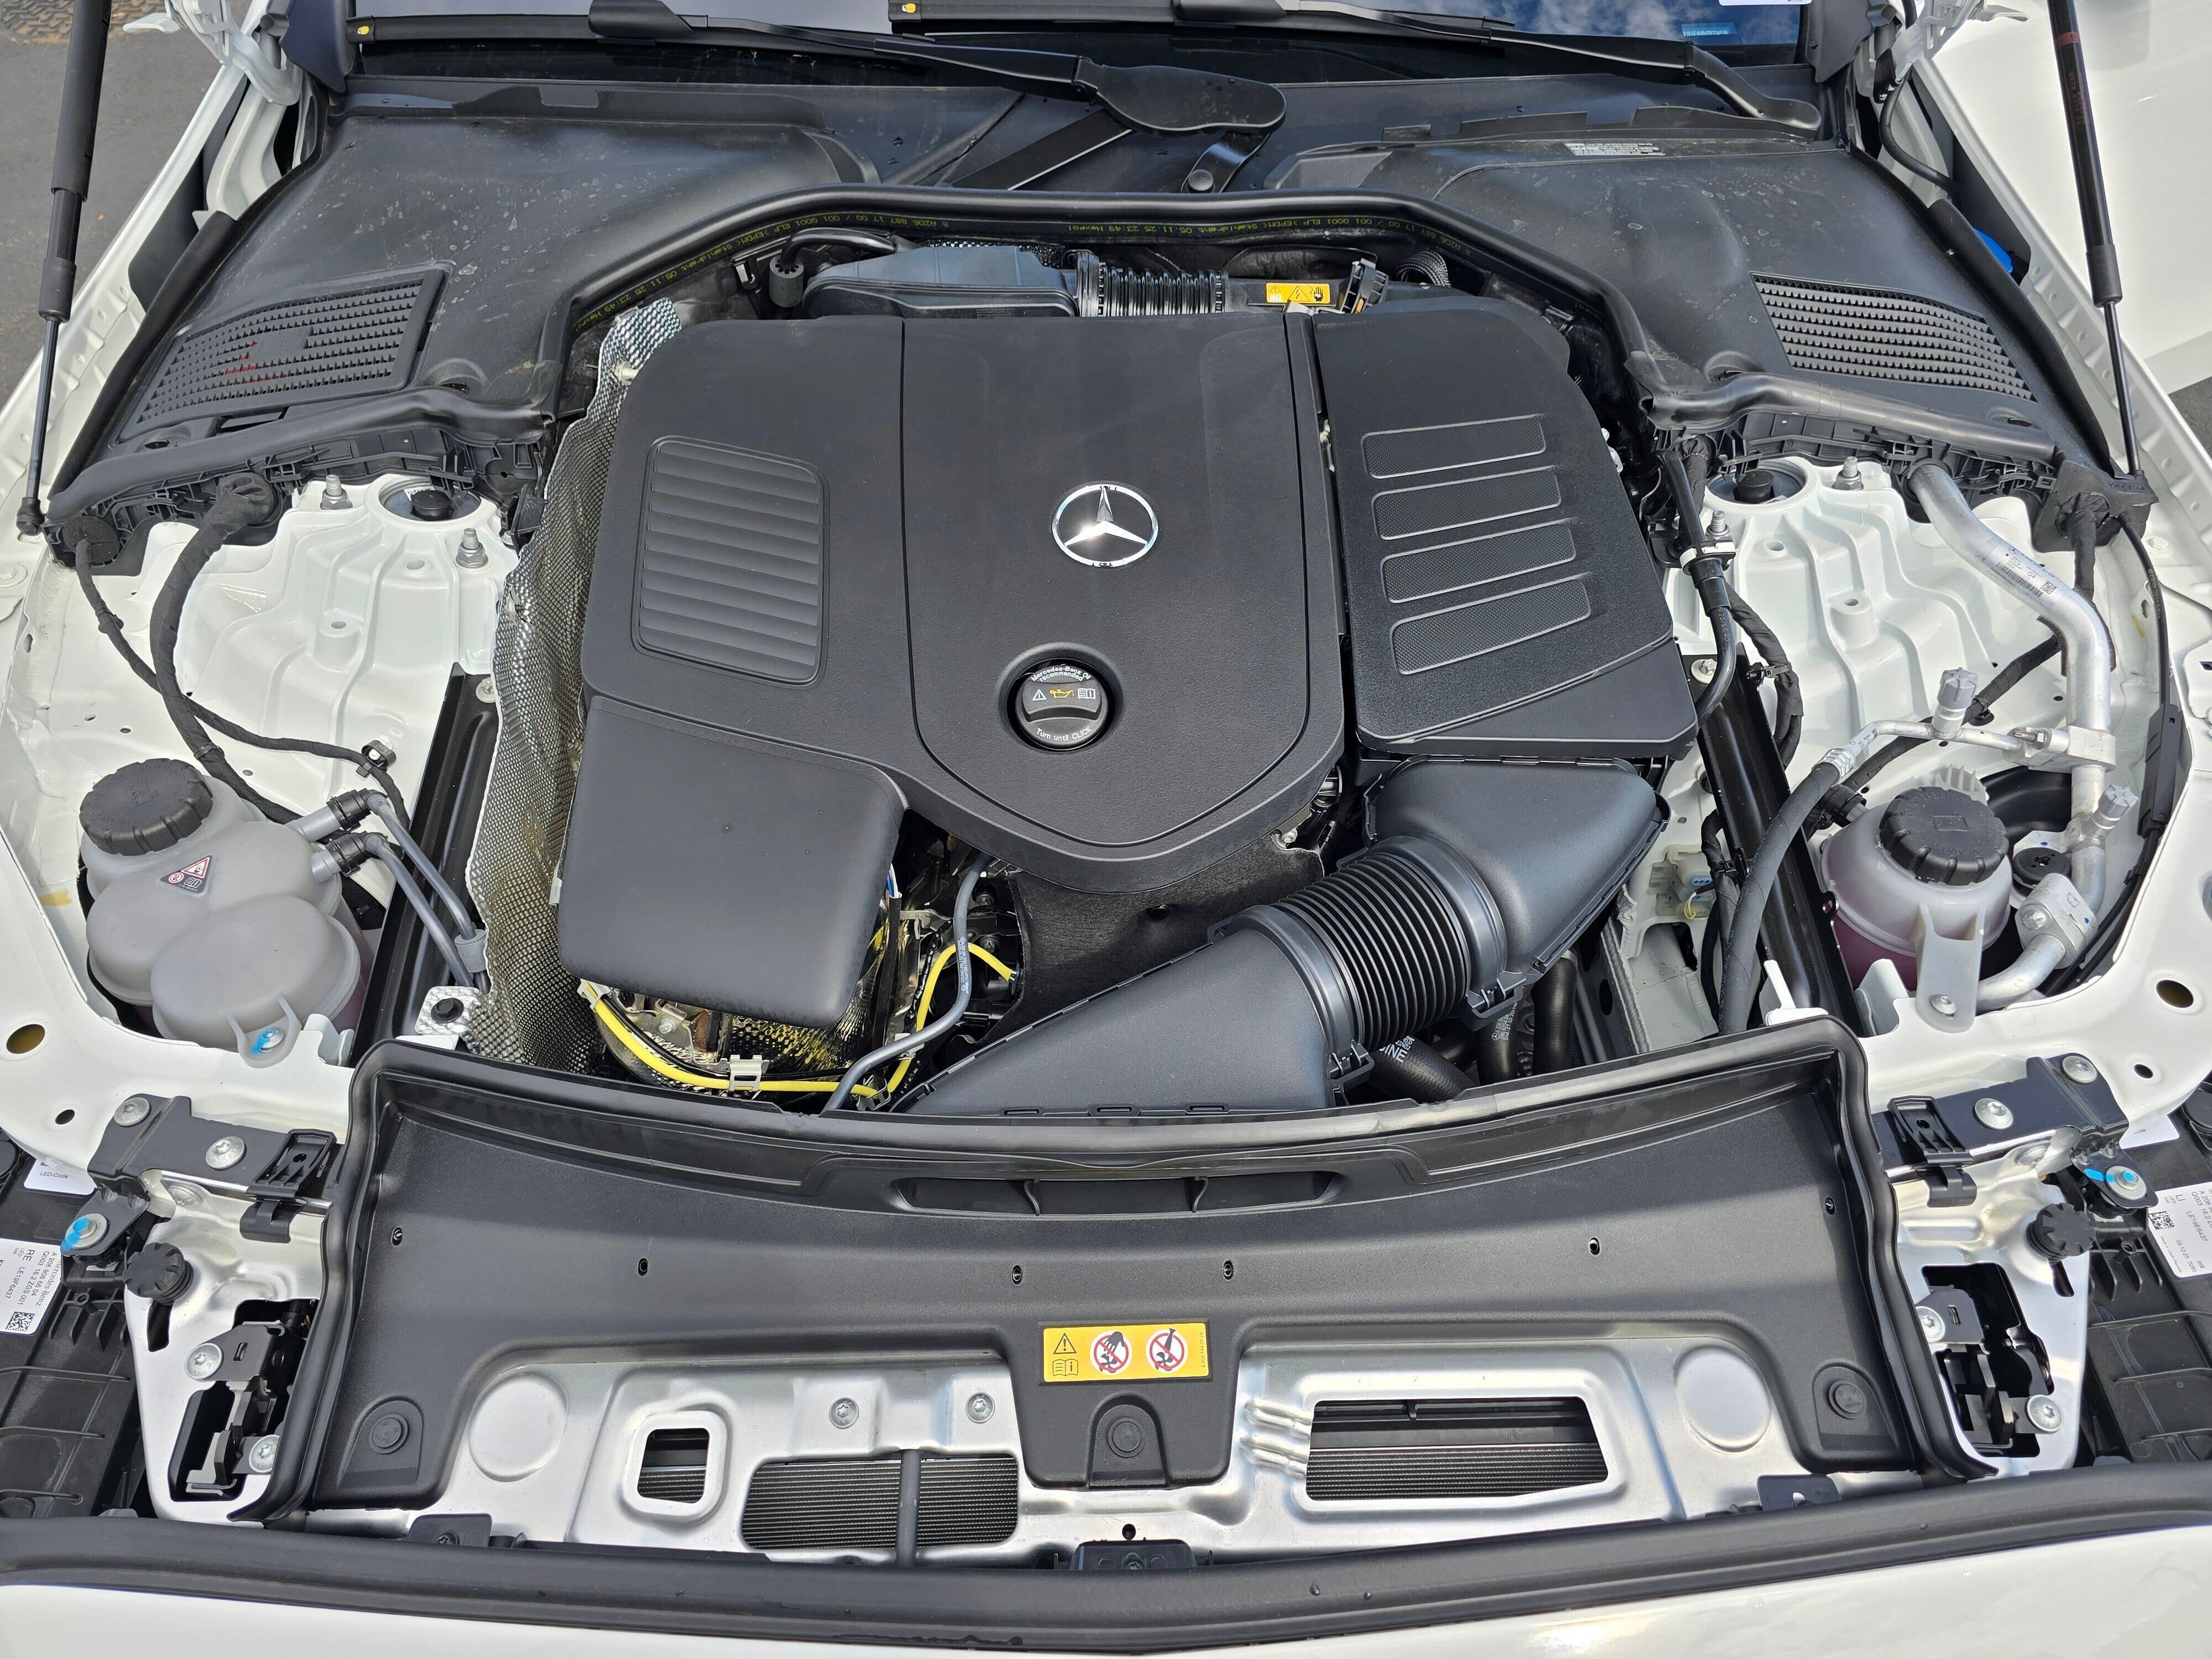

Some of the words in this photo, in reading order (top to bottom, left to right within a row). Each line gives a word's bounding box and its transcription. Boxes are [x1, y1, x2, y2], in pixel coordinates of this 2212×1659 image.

[774, 222, 791, 232] ELP
[913, 218, 937, 227] A206
[1198, 223, 1258, 233] Stahldraht
[680, 244, 732, 271] Stahldraht
[604, 294, 632, 312] 23:49
[575, 312, 602, 332] Hexpol
[1031, 666, 1082, 681] Mercedes-Benz
[1039, 671, 1084, 682] recommended
[1036, 728, 1051, 739] Turn
[1072, 726, 1092, 739] CLICK
[2192, 1191, 2203, 1206] Q003
[2201, 1195, 2211, 1206] 206
[2187, 1211, 2208, 1242] LE19E6437
[22, 1249, 35, 1261] RE
[38, 1251, 49, 1266] Q003
[45, 1258, 55, 1268] 206
[30, 1269, 40, 1280] 16.2
[39, 1269, 49, 1279] 906
[5, 1266, 25, 1298] LE19F6437
[23, 1281, 34, 1294] ZGS
[18, 1295, 27, 1305] 001
